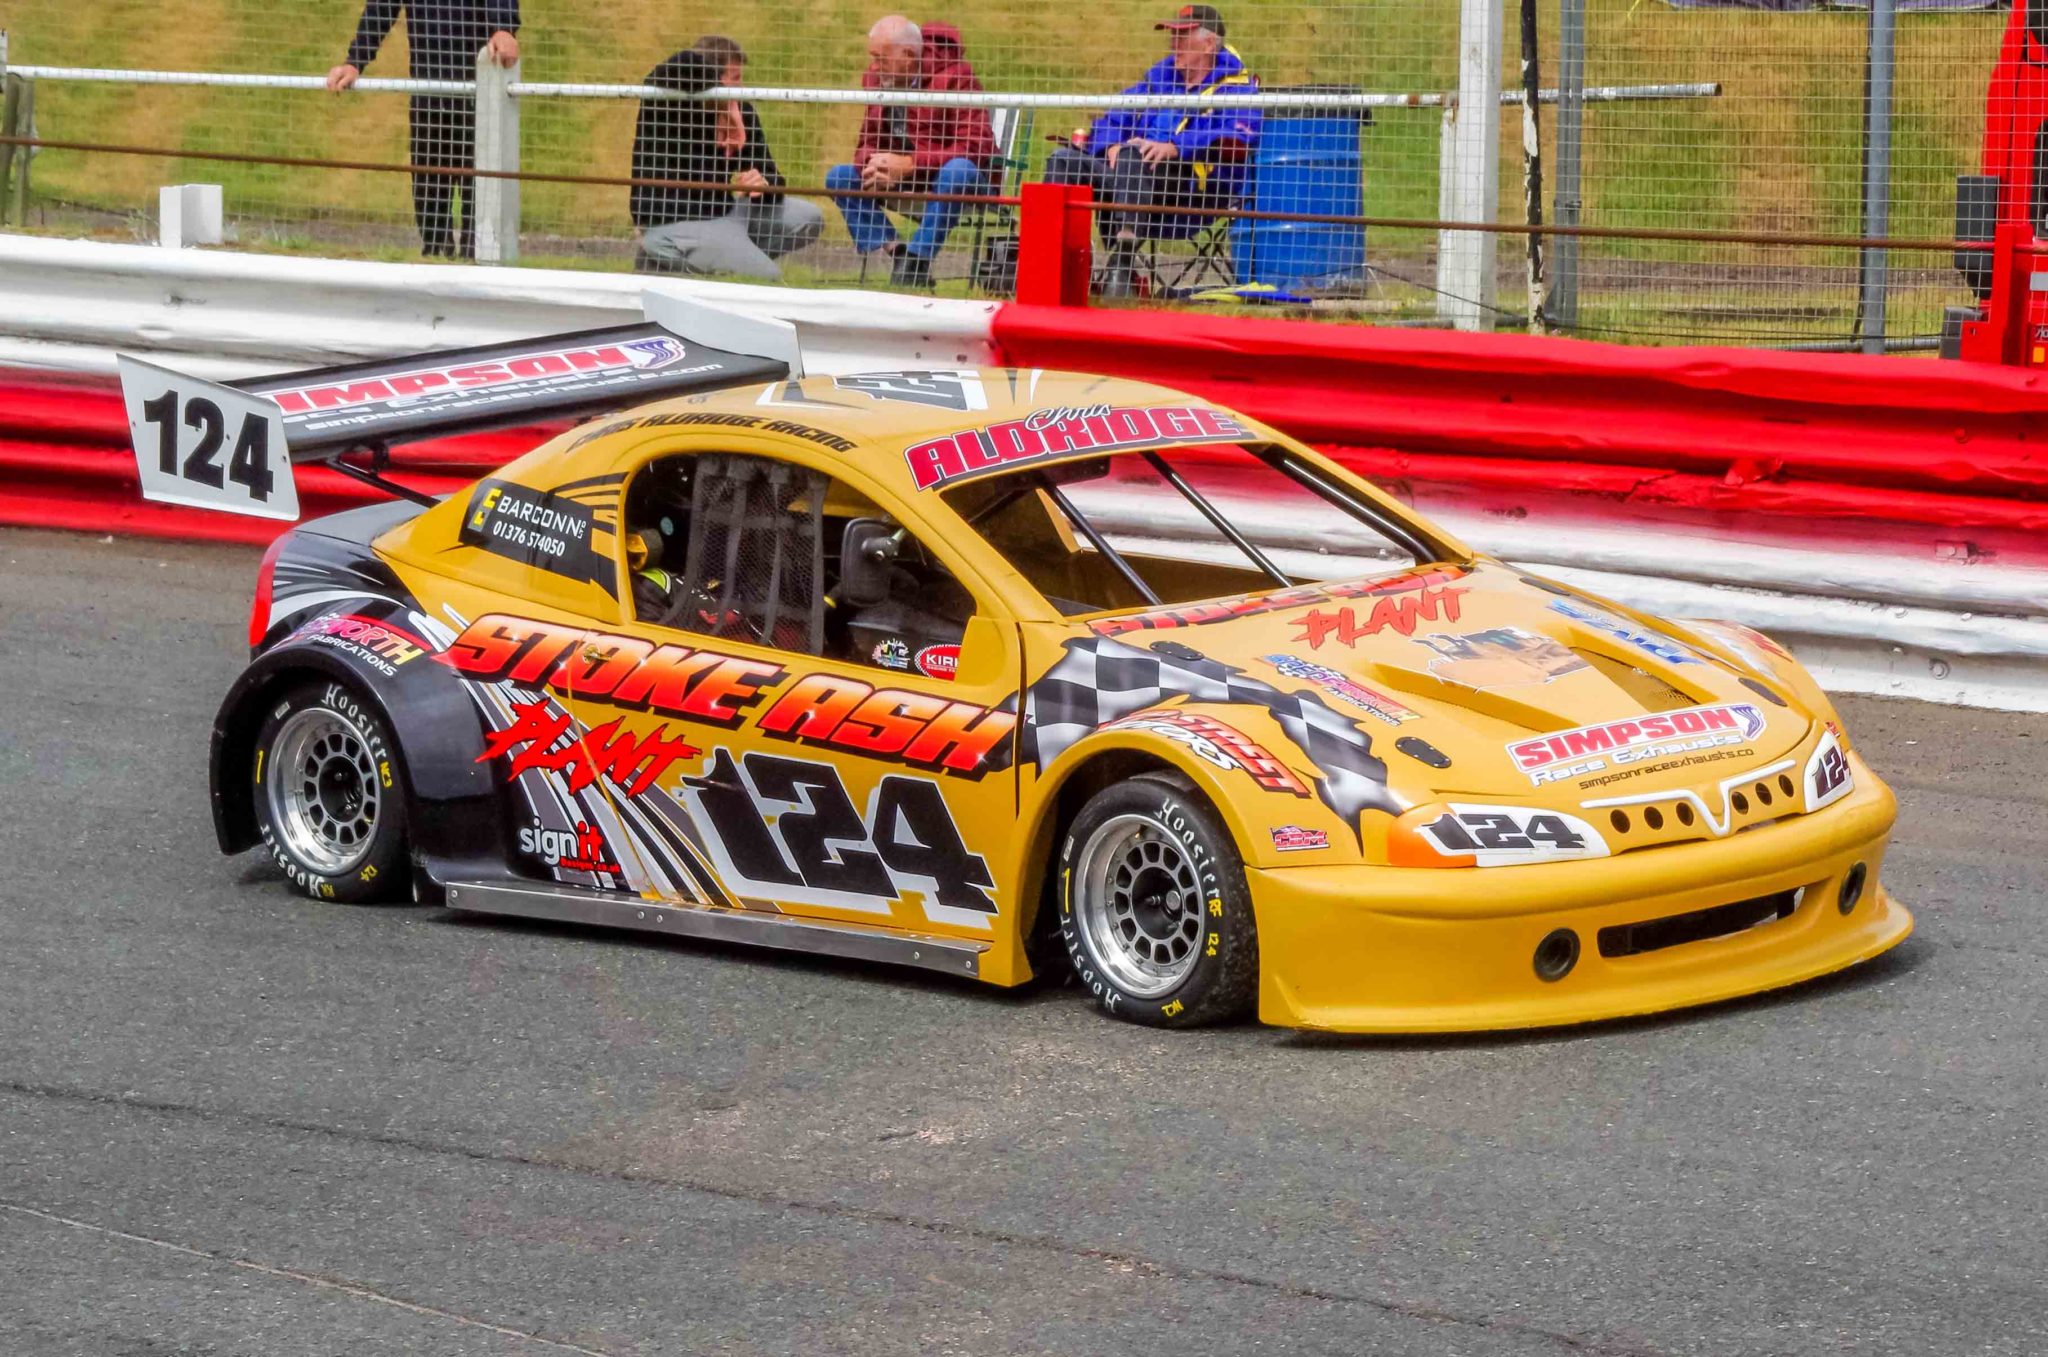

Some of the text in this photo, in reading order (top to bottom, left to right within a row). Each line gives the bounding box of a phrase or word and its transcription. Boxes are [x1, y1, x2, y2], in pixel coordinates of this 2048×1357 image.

[269, 346, 631, 414] IMPSON
[143, 389, 274, 503] 124
[762, 420, 858, 453] RACING
[1025, 402, 1113, 432] Chris
[904, 407, 1244, 491] ALDRIDGE
[493, 520, 566, 557] 01376 574050
[497, 495, 582, 538] BARCONN
[1288, 586, 1475, 651] PLANT
[307, 633, 398, 677] FABRICATIONS
[450, 614, 1017, 776] STOKE ASH
[1323, 686, 1402, 727] FABRICATIONS
[474, 699, 702, 799] PLANT
[1513, 707, 1739, 769] SIMPSON
[1526, 733, 1744, 788] Race Exhausts
[682, 746, 998, 918] 124
[1153, 797, 1220, 898] Hoosier
[1421, 813, 1587, 850] 124
